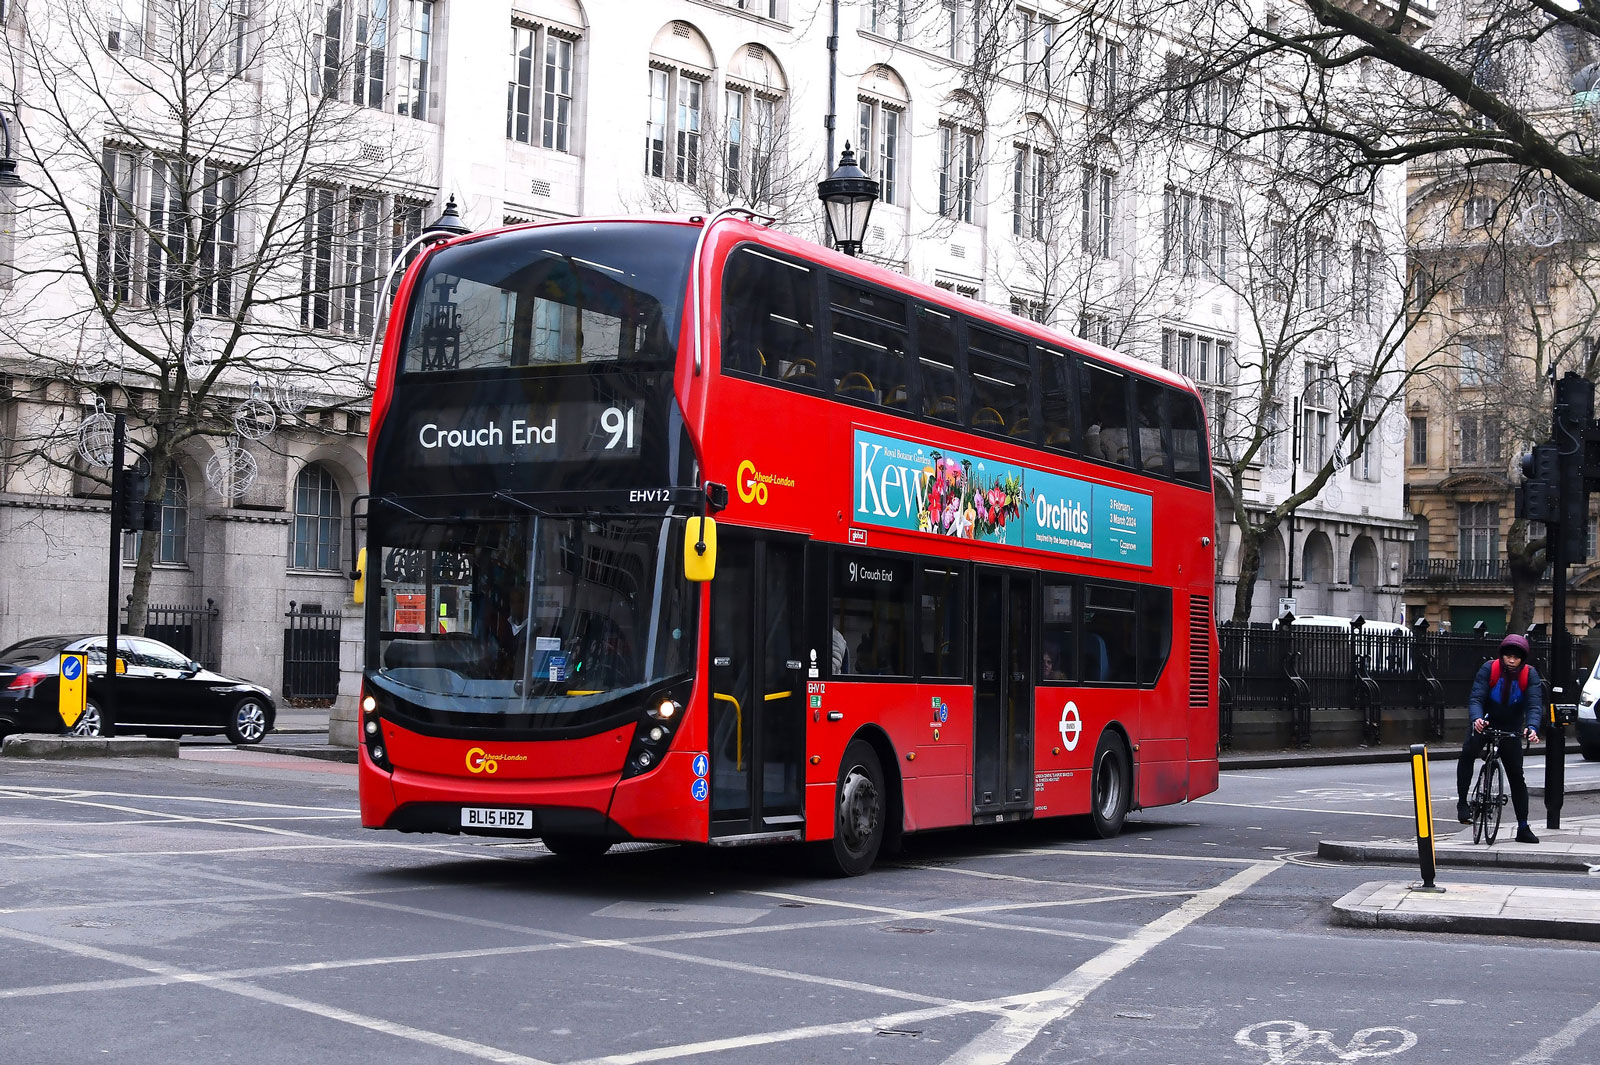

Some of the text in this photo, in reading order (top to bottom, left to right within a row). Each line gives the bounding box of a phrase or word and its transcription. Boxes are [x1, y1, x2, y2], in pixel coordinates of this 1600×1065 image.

[419, 406, 634, 450] Crouch End 91
[884, 446, 896, 460] Royal
[736, 460, 768, 506] Go
[754, 472, 795, 488] Ahead-London
[858, 441, 935, 520] Kew
[629, 489, 670, 502] EHV12
[1036, 494, 1088, 535] Orchids
[1110, 498, 1113, 509] 3
[1114, 500, 1130, 514] February
[1114, 514, 1126, 526] March
[849, 561, 892, 582] 91 Crouch End
[465, 747, 498, 774] Go
[468, 810, 524, 826] BL15 HBZ
